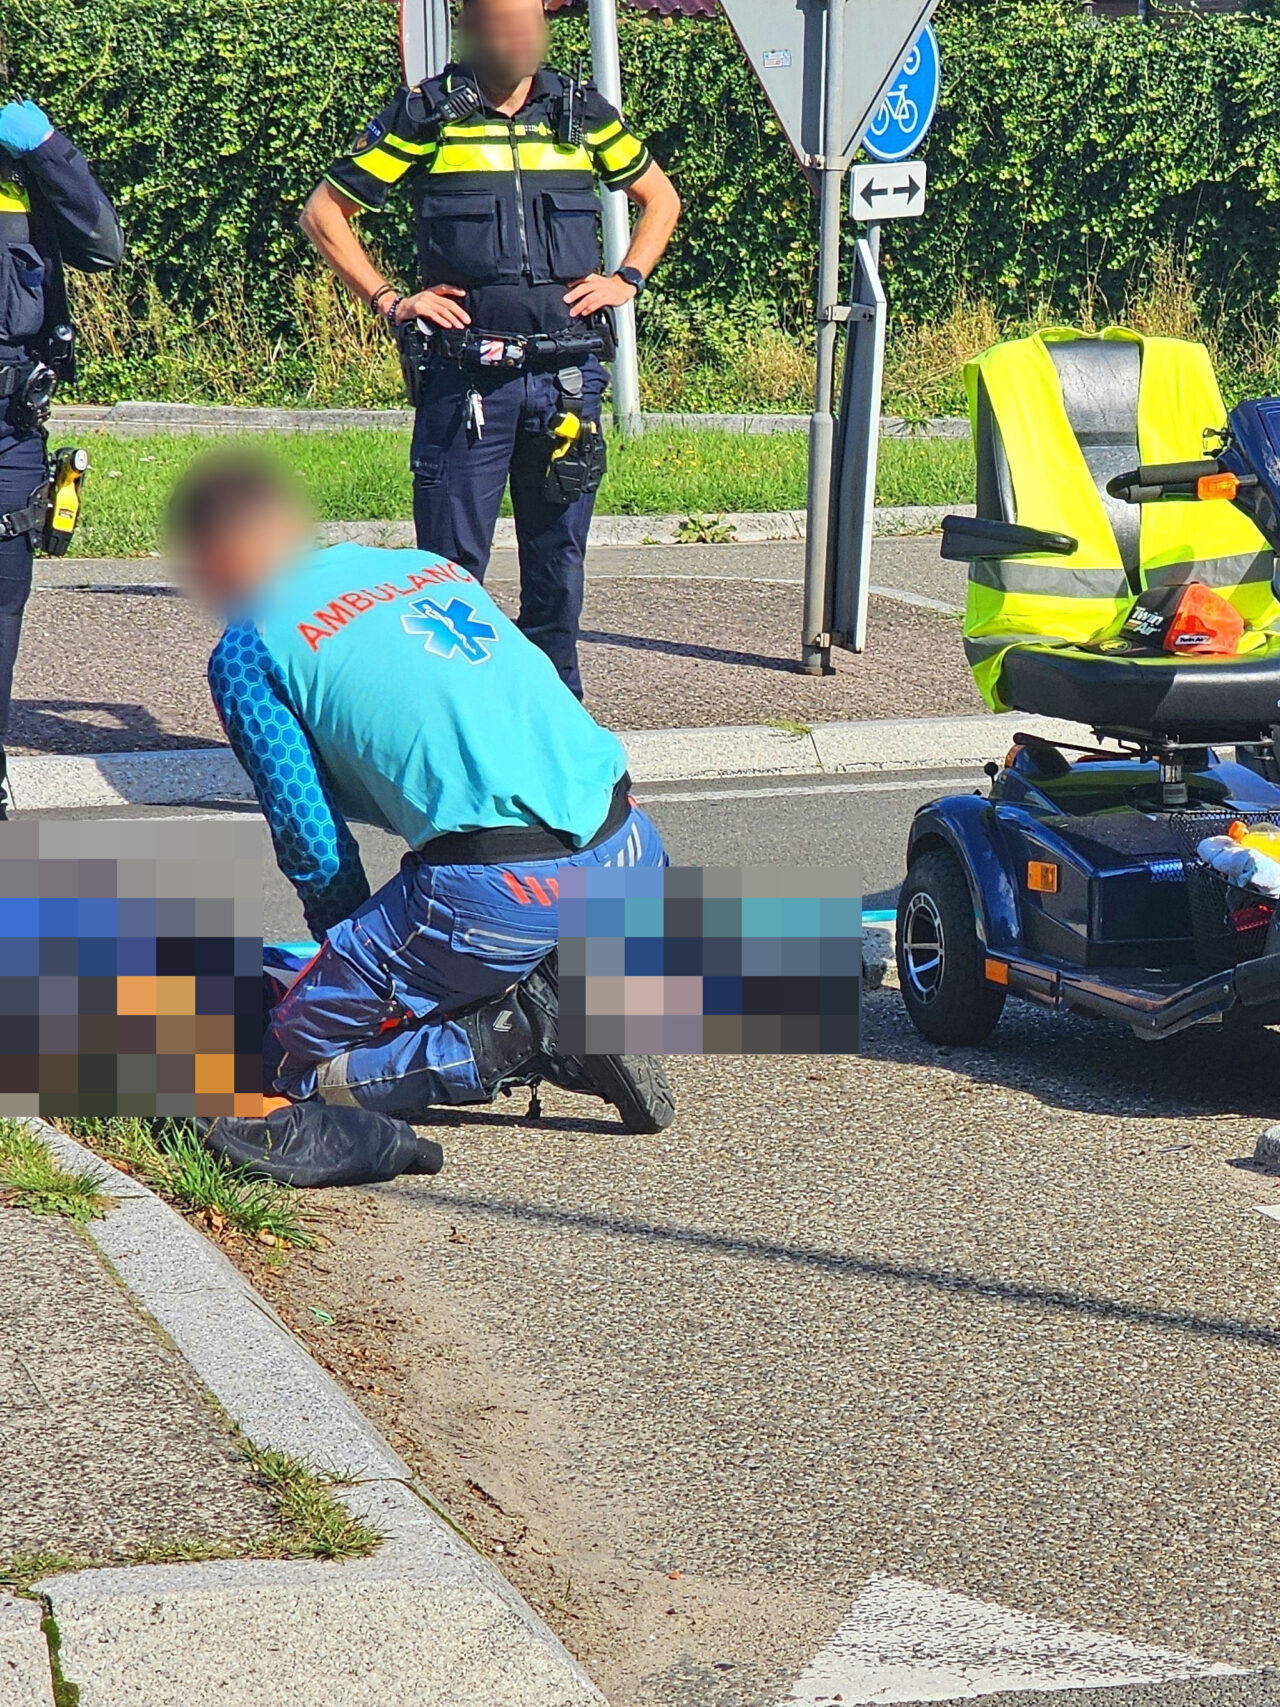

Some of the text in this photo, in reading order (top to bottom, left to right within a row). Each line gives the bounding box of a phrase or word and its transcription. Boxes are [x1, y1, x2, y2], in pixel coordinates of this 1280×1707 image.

[297, 562, 474, 652] AMBULANC
[1131, 606, 1164, 626] Twin
[1133, 621, 1158, 636] Air
